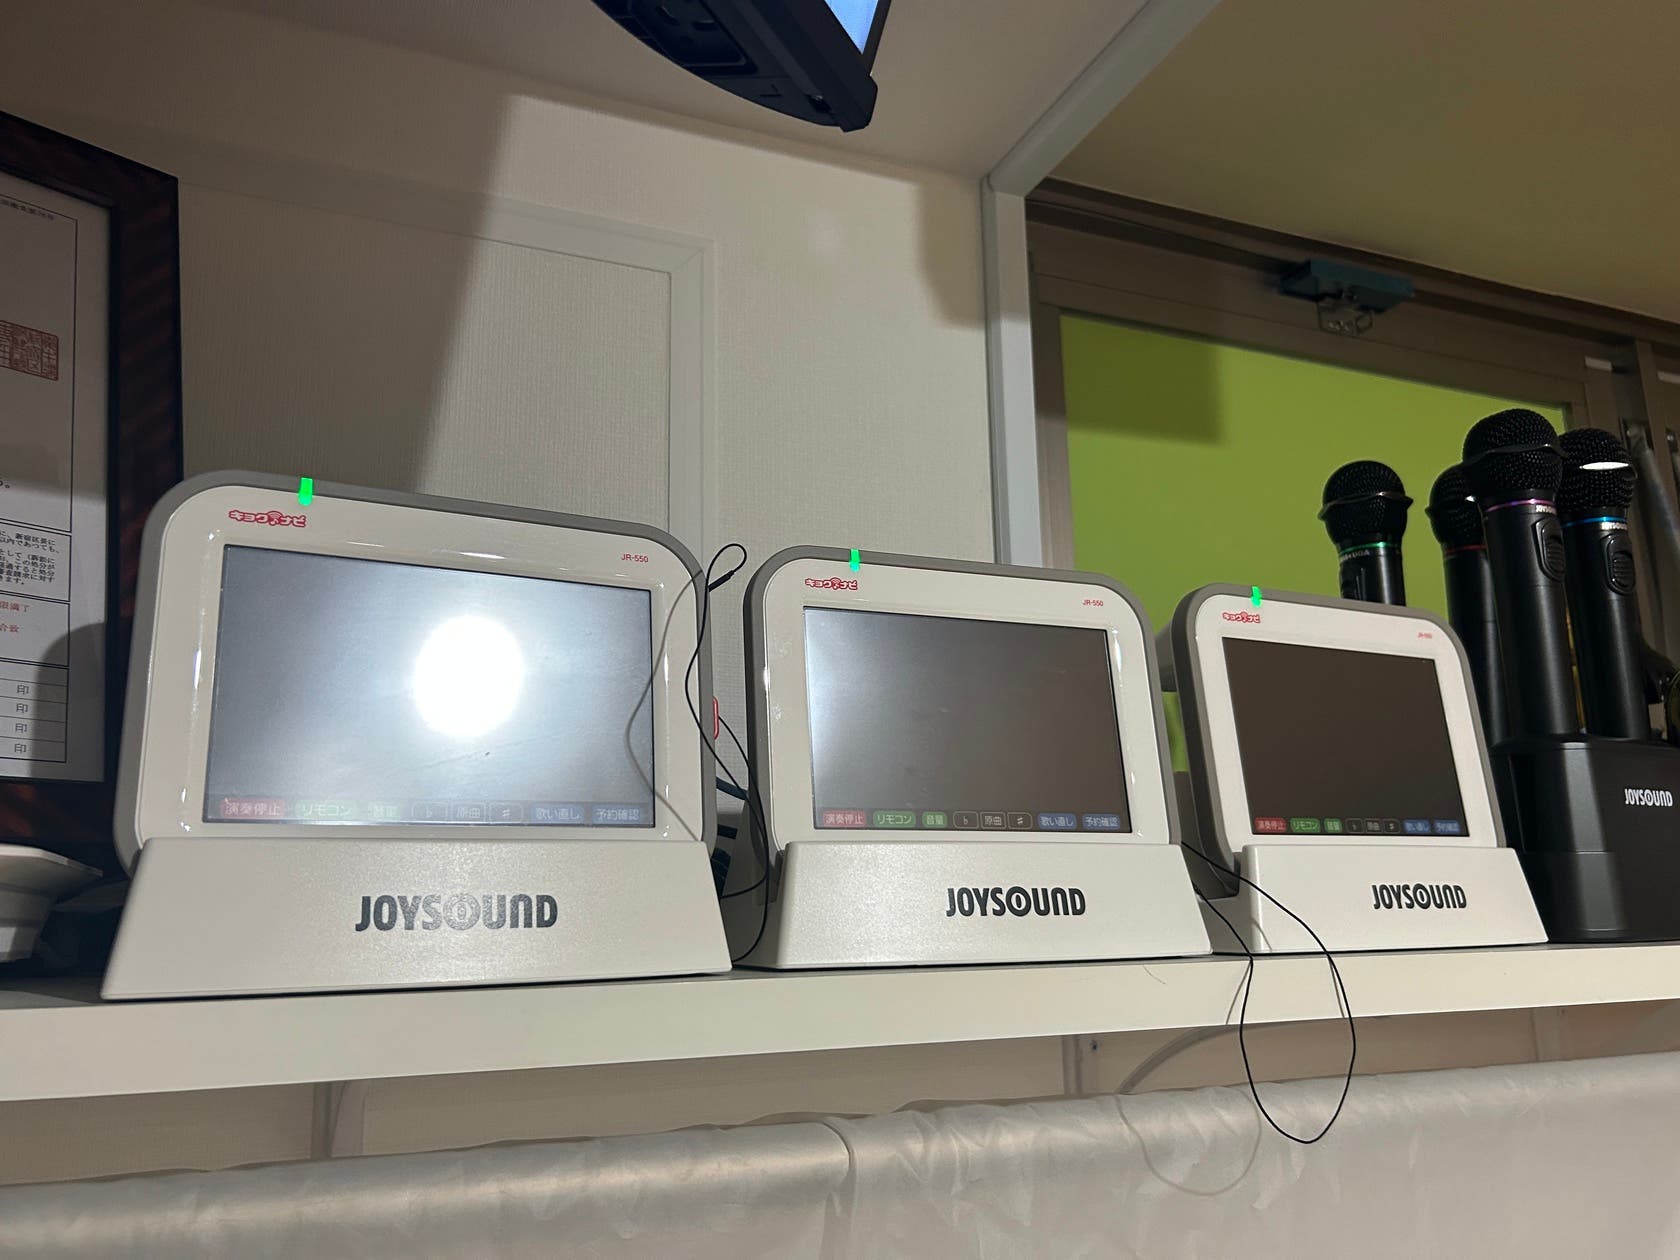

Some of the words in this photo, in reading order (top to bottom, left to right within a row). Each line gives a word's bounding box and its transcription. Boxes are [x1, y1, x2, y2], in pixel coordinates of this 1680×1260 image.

[621, 554, 649, 563] JR-550
[16, 684, 29, 695] 印
[16, 703, 28, 713] 印
[15, 723, 27, 733] 印
[14, 743, 27, 754] 印
[1624, 788, 1673, 807] JOYSOUND
[302, 803, 353, 817] リモコン
[536, 807, 580, 821] 歌い直し
[596, 808, 640, 822] 予約確認
[877, 814, 912, 825] リモコン
[946, 886, 1086, 917] JOYSOUND
[1372, 883, 1467, 909] JOYSOUND
[355, 893, 558, 932] JOYSOUND
